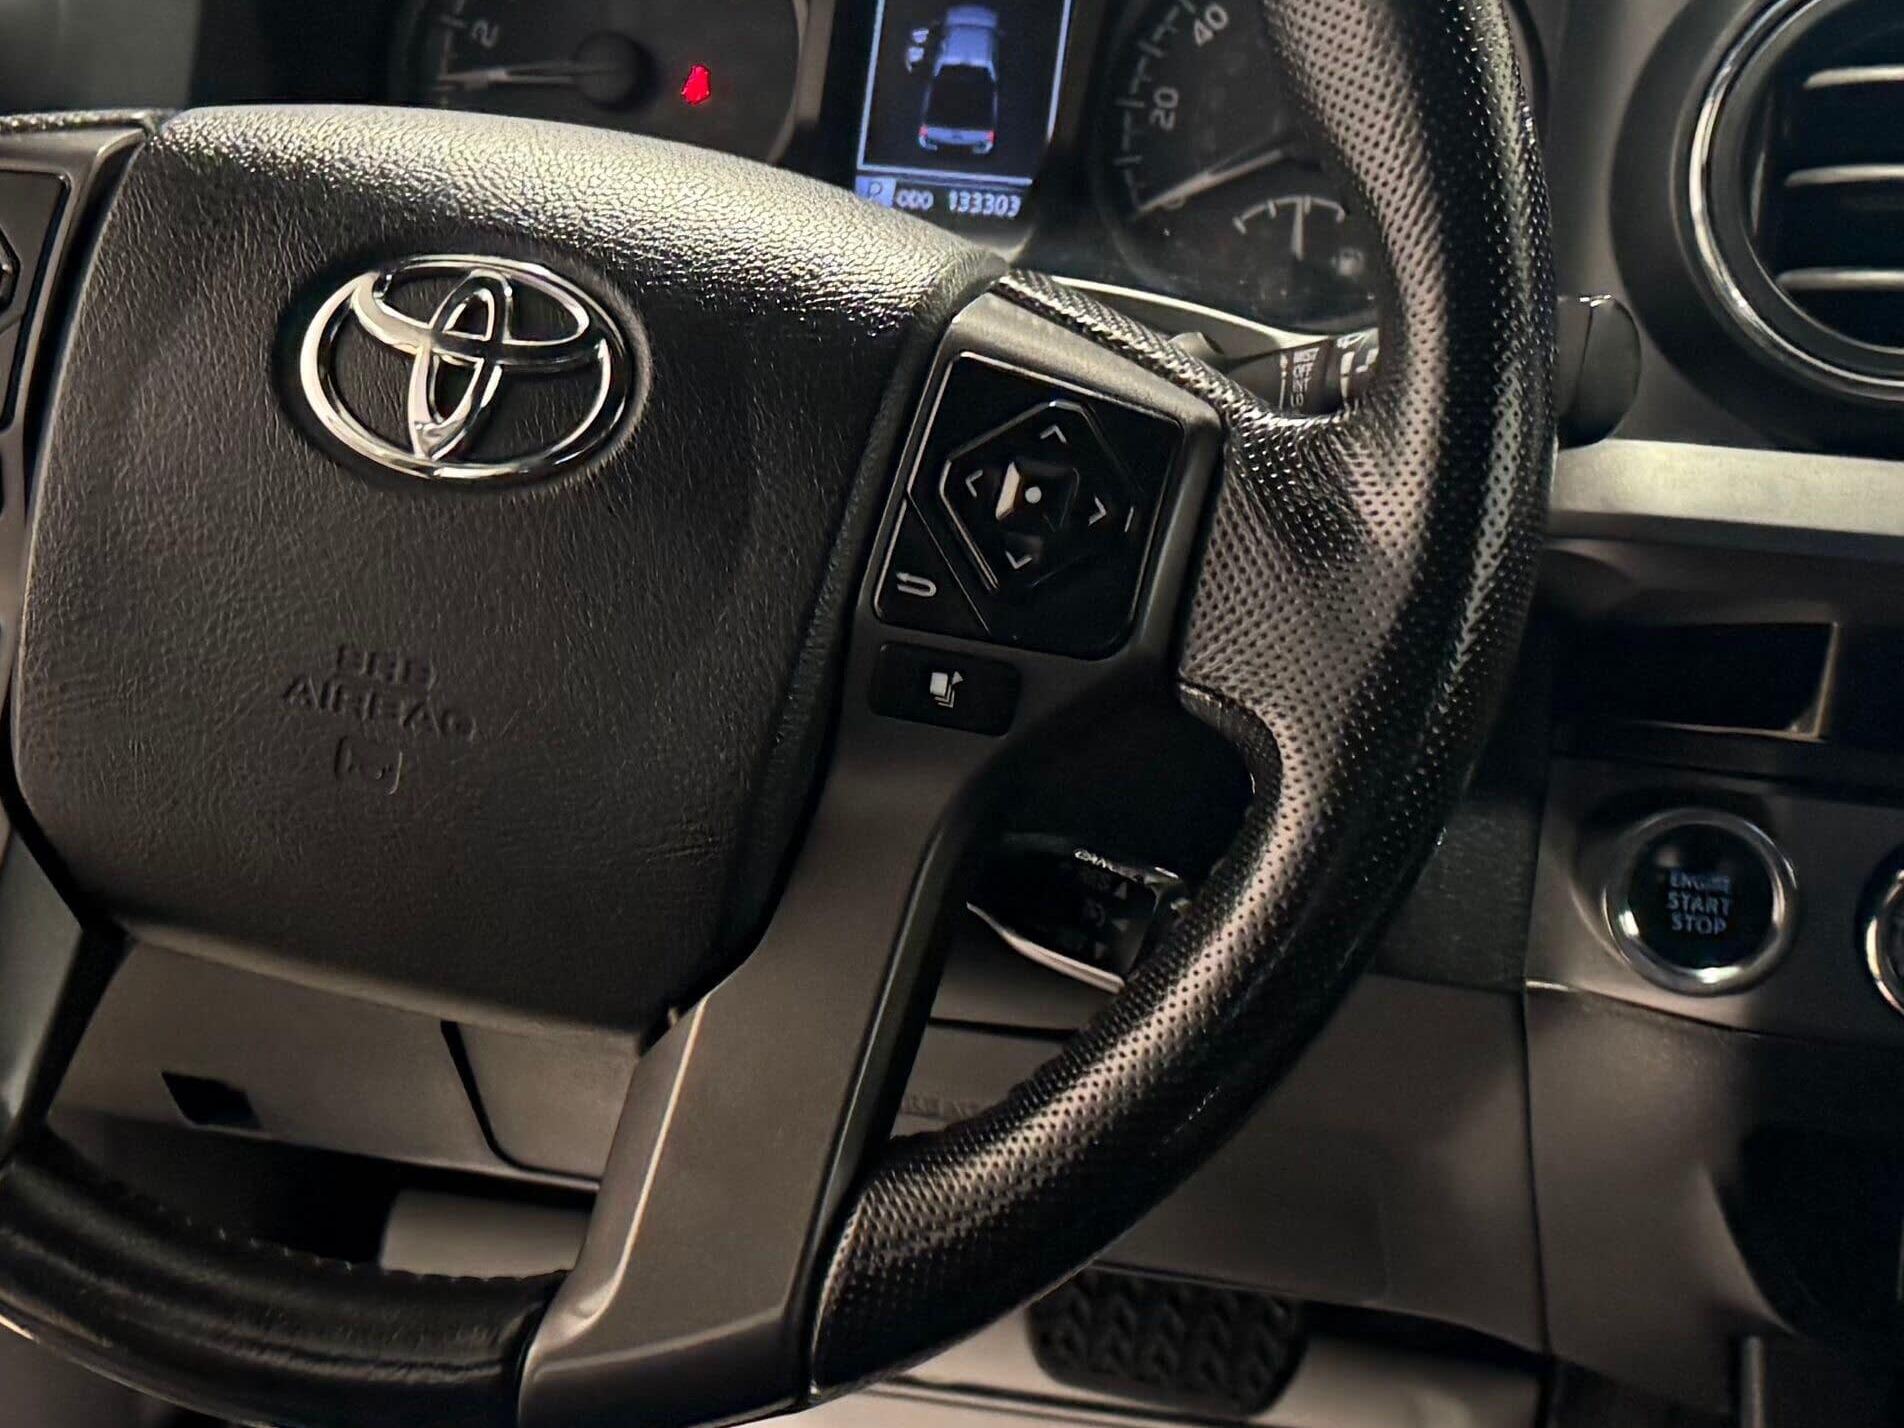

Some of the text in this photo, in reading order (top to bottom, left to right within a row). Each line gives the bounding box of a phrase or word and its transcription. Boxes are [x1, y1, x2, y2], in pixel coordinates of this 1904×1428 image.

[471, 20, 498, 49] 2
[1193, 2, 1231, 47] 40
[1149, 86, 1179, 131] 20
[948, 190, 1022, 218] 133303
[1667, 892, 1731, 916] START
[1671, 912, 1726, 935] STOP
